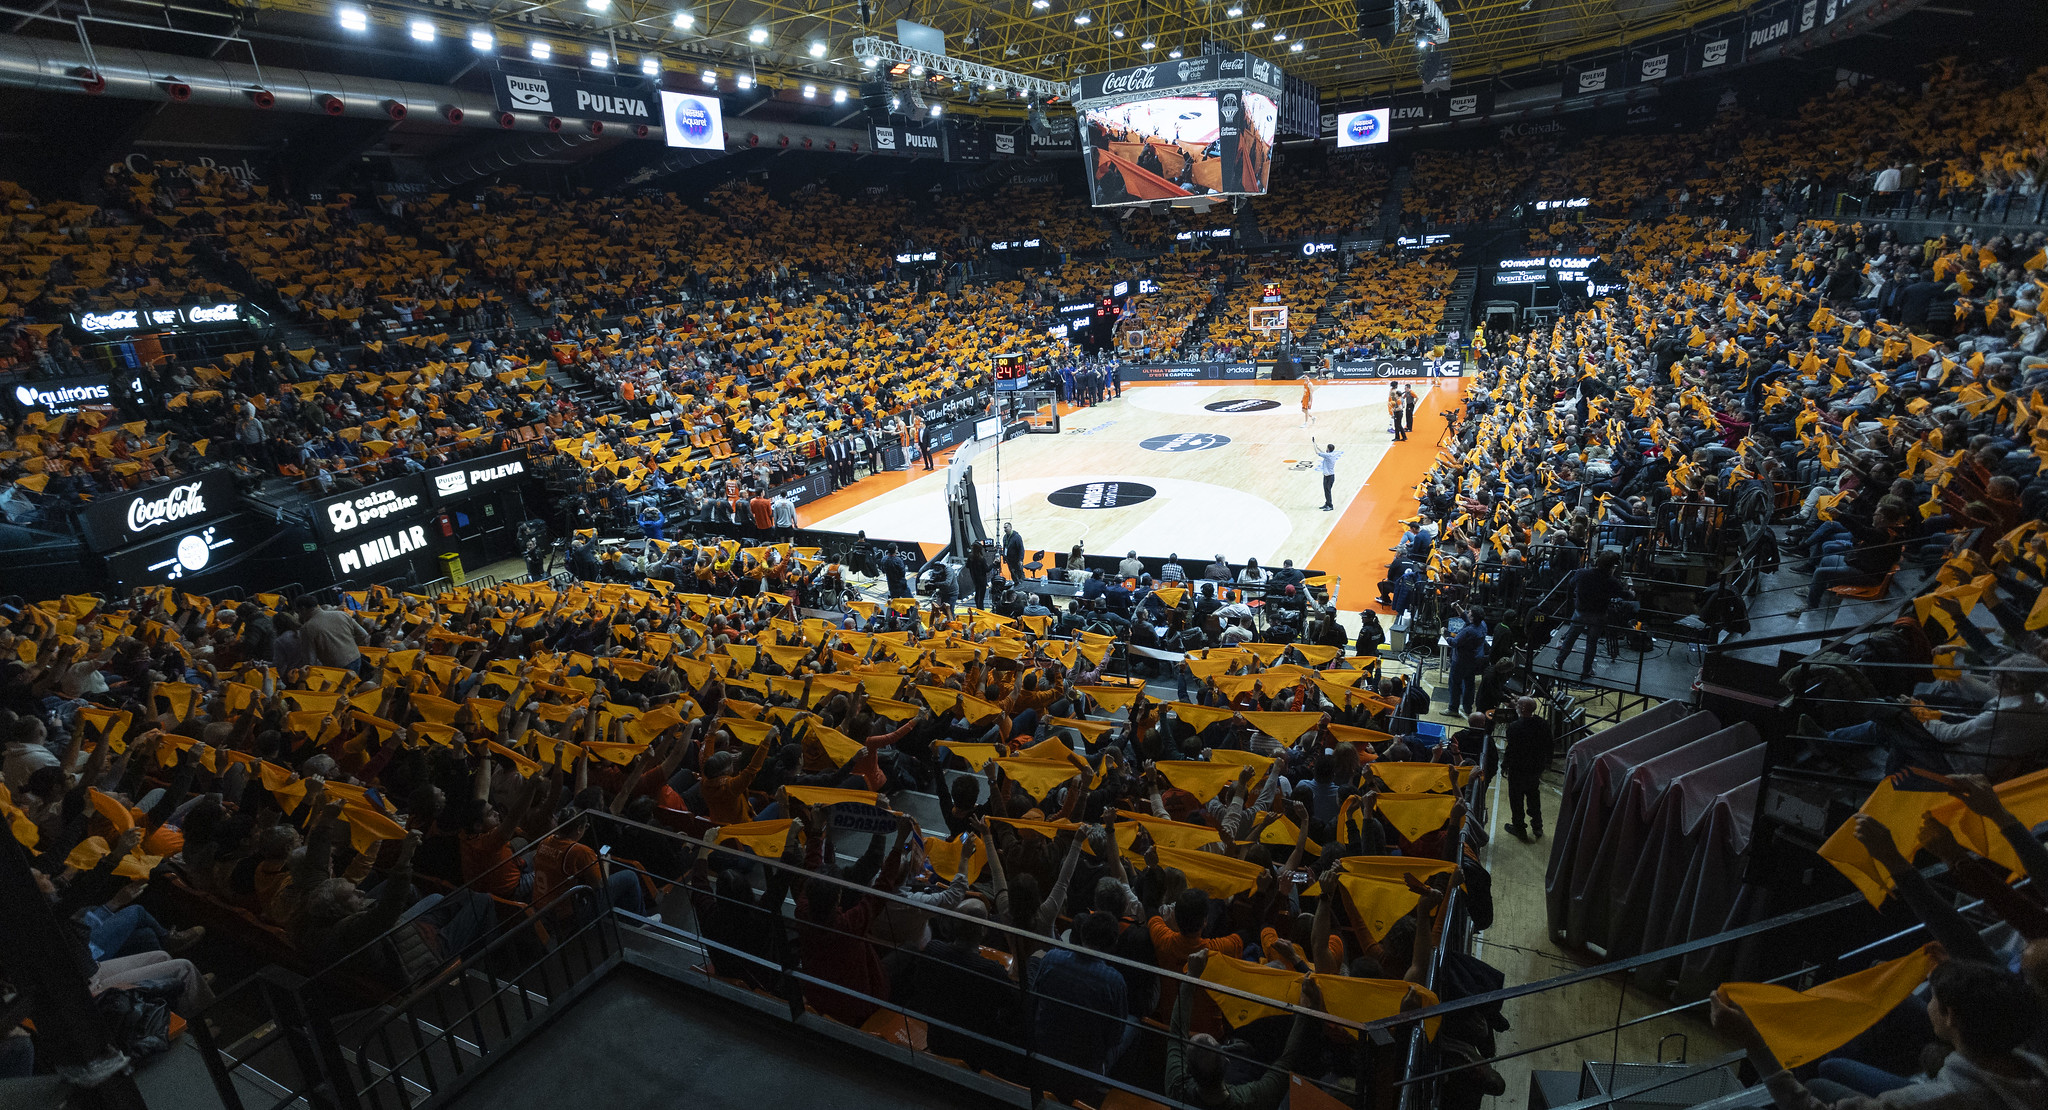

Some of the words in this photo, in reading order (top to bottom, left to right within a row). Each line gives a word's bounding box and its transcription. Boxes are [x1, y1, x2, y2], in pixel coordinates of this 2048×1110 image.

[1749, 19, 1788, 49] PULEVA
[1705, 43, 1727, 54] PULEVA
[1221, 59, 1245, 71] Coca-Cola
[1642, 58, 1667, 70] PULEVA
[1102, 66, 1158, 95] Coca-Cola
[1581, 72, 1605, 81] PULEVA
[511, 80, 547, 94] PULEVA
[576, 90, 649, 118] PULEVA
[877, 129, 894, 138] PULEVA
[905, 132, 938, 149] PULEVA
[189, 304, 239, 323] Coca-Cola
[996, 366, 1012, 379] 24
[1226, 366, 1254, 374] endesa
[1382, 365, 1417, 377] Midea
[438, 473, 464, 486] PULEVA
[469, 461, 525, 486] PULEVA
[128, 481, 207, 532] Coca-Cola
[355, 489, 397, 510] caixa
[358, 494, 419, 525] popular
[359, 525, 428, 568] MILAR
